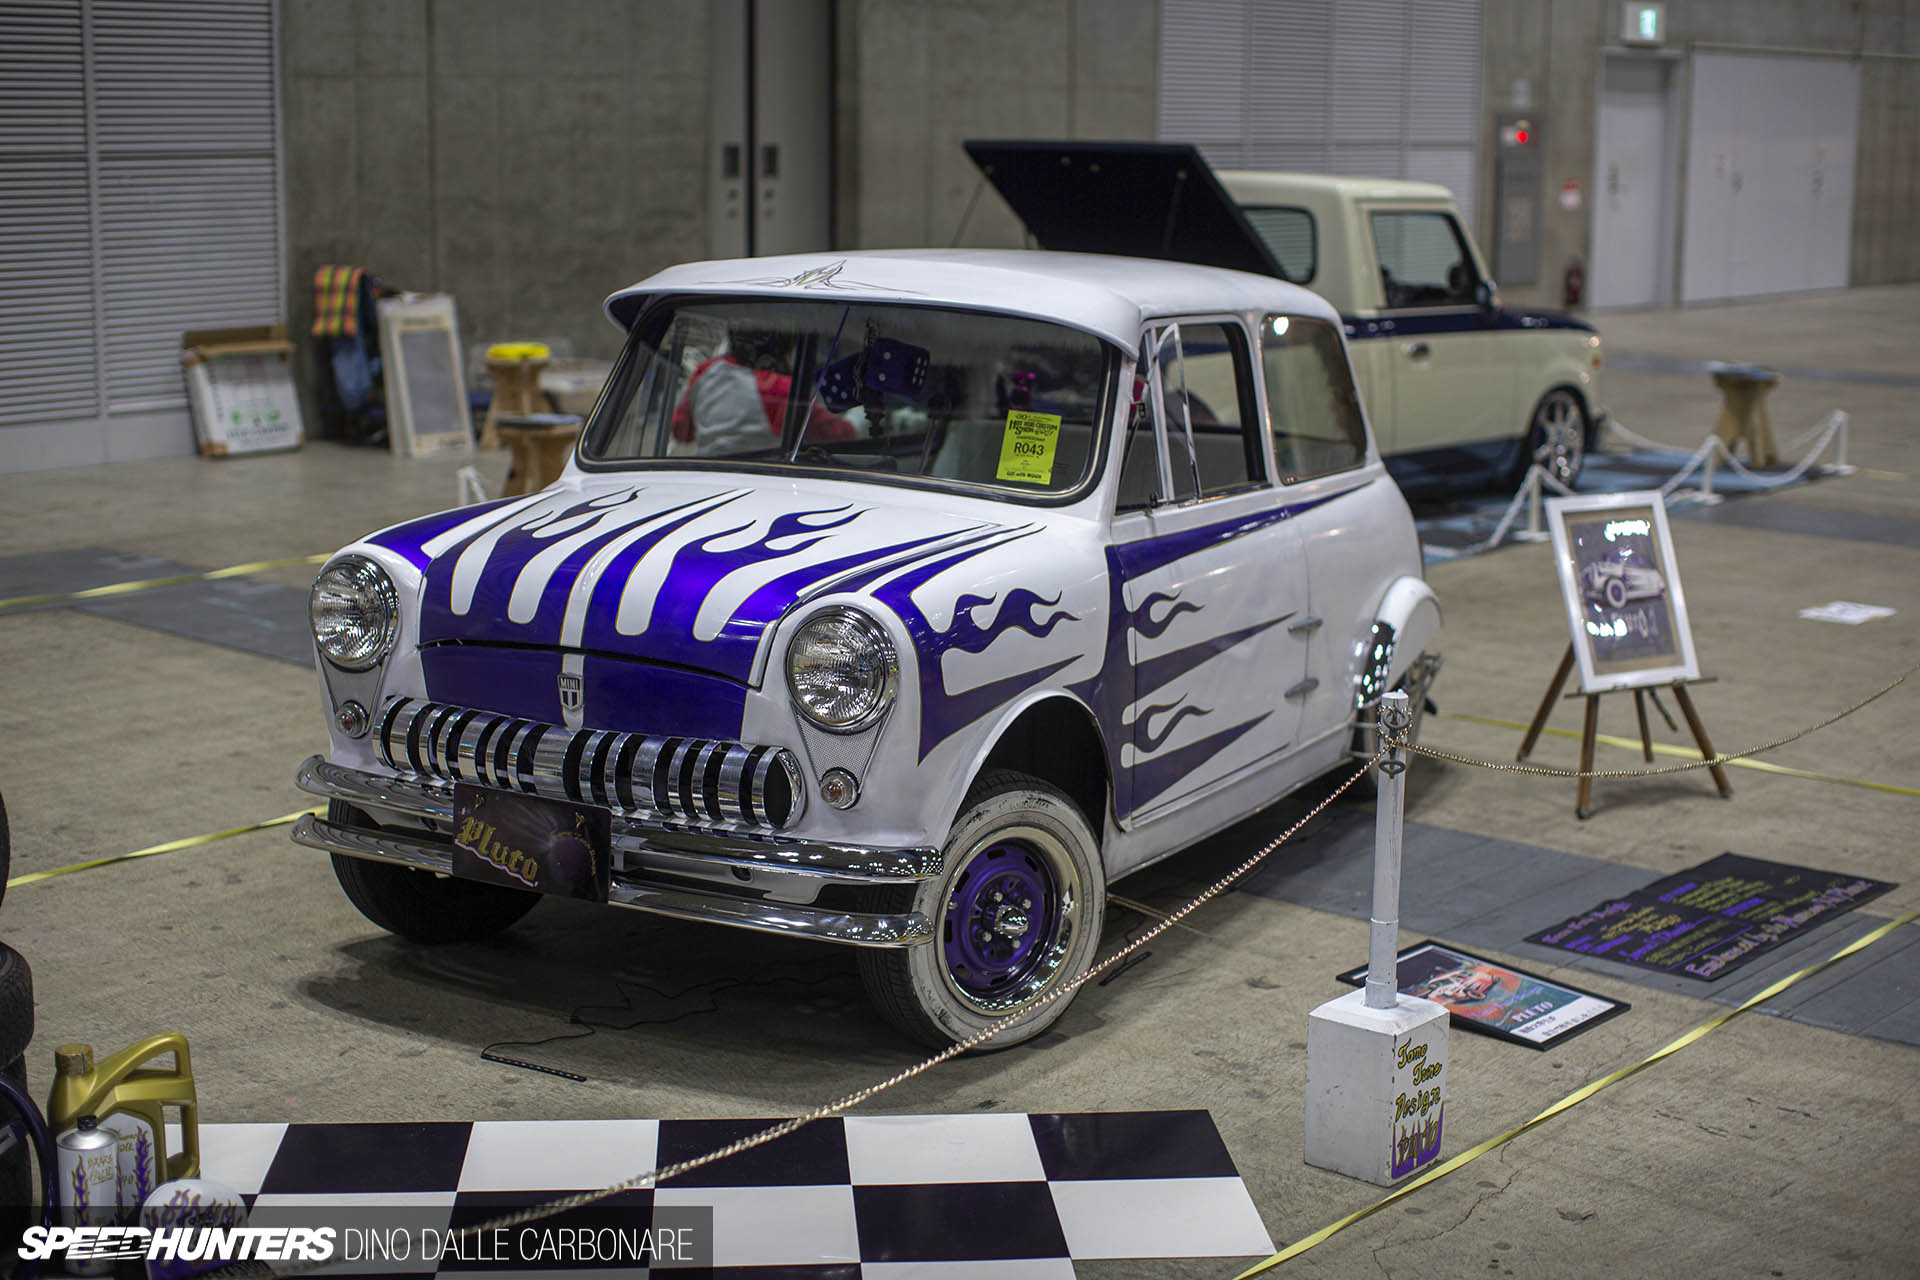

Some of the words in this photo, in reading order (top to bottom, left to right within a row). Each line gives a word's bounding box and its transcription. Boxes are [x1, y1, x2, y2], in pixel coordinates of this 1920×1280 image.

[1014, 441, 1045, 456] R043
[560, 677, 579, 690] MINI
[1395, 1086, 1441, 1123] Design
